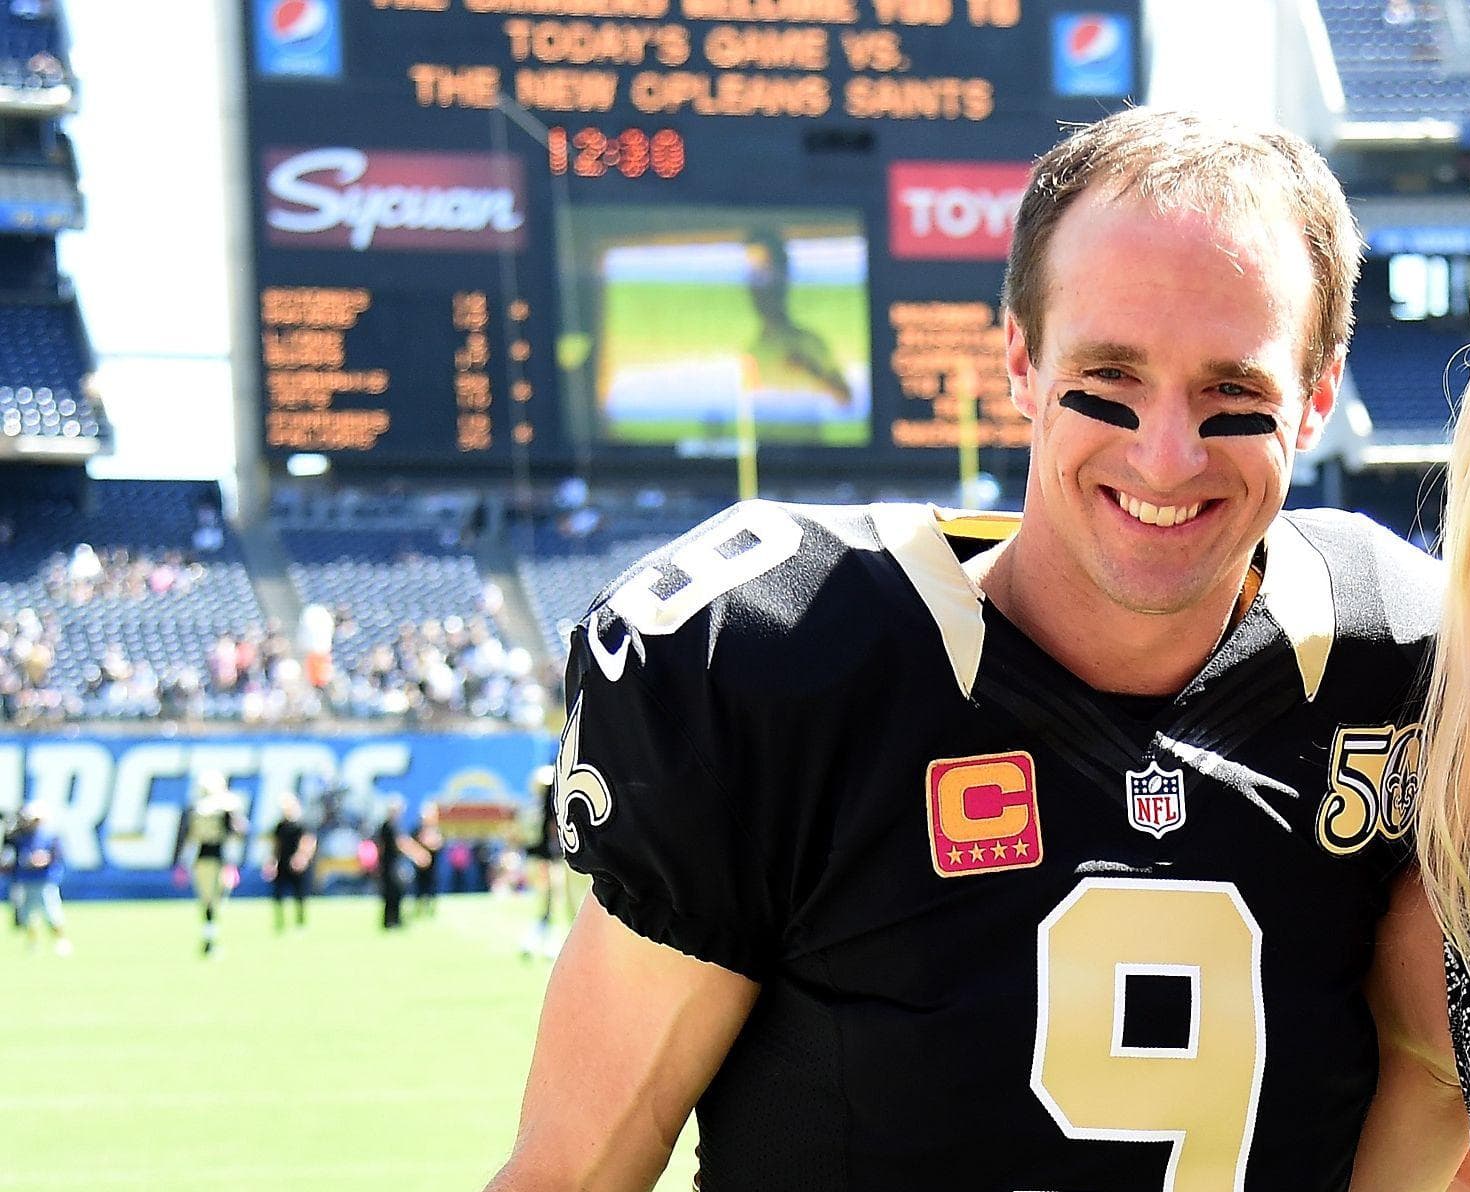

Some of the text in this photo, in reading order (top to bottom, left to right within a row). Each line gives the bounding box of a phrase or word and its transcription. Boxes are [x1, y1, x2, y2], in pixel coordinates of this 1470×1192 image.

[504, 19, 690, 66] TODAY'S
[705, 26, 828, 70] GAME
[408, 63, 499, 109] THE
[514, 68, 619, 112] NEW
[844, 76, 994, 121] SAINTS
[267, 147, 526, 250] Sycuan
[906, 187, 1023, 238] TOY
[0, 744, 411, 869] RGERS
[938, 761, 1031, 843] C
[1137, 797, 1177, 825] NFL
